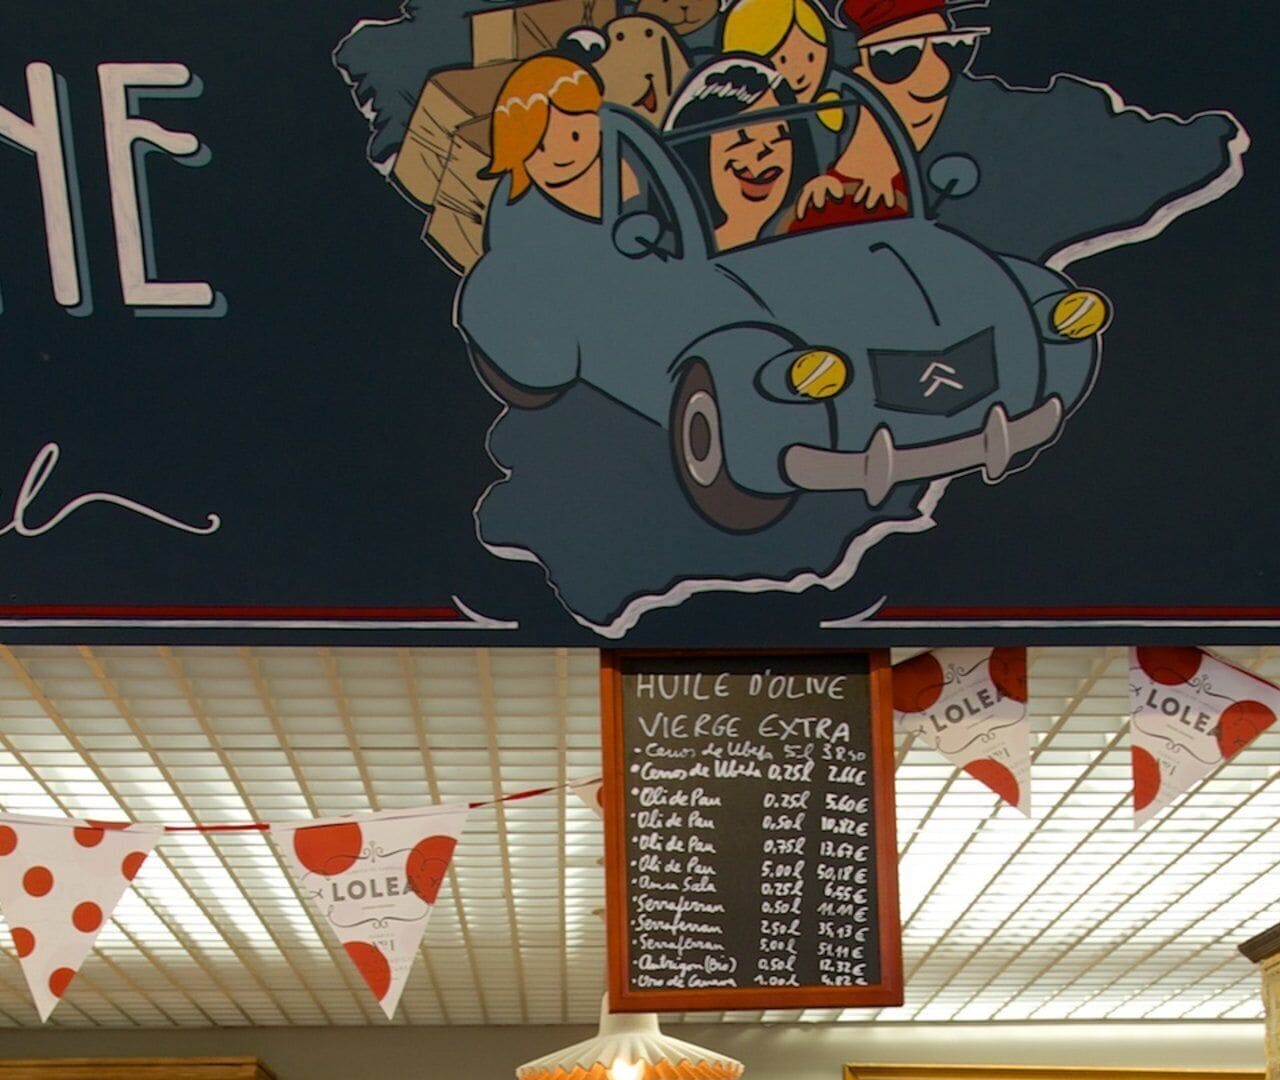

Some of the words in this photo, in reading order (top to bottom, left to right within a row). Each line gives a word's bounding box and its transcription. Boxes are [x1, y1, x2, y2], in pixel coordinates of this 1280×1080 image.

[637, 673, 730, 700] HUILE
[749, 669, 847, 700] D'OLIVE
[638, 713, 741, 739] VIERGE
[759, 714, 850, 743] EXTRA
